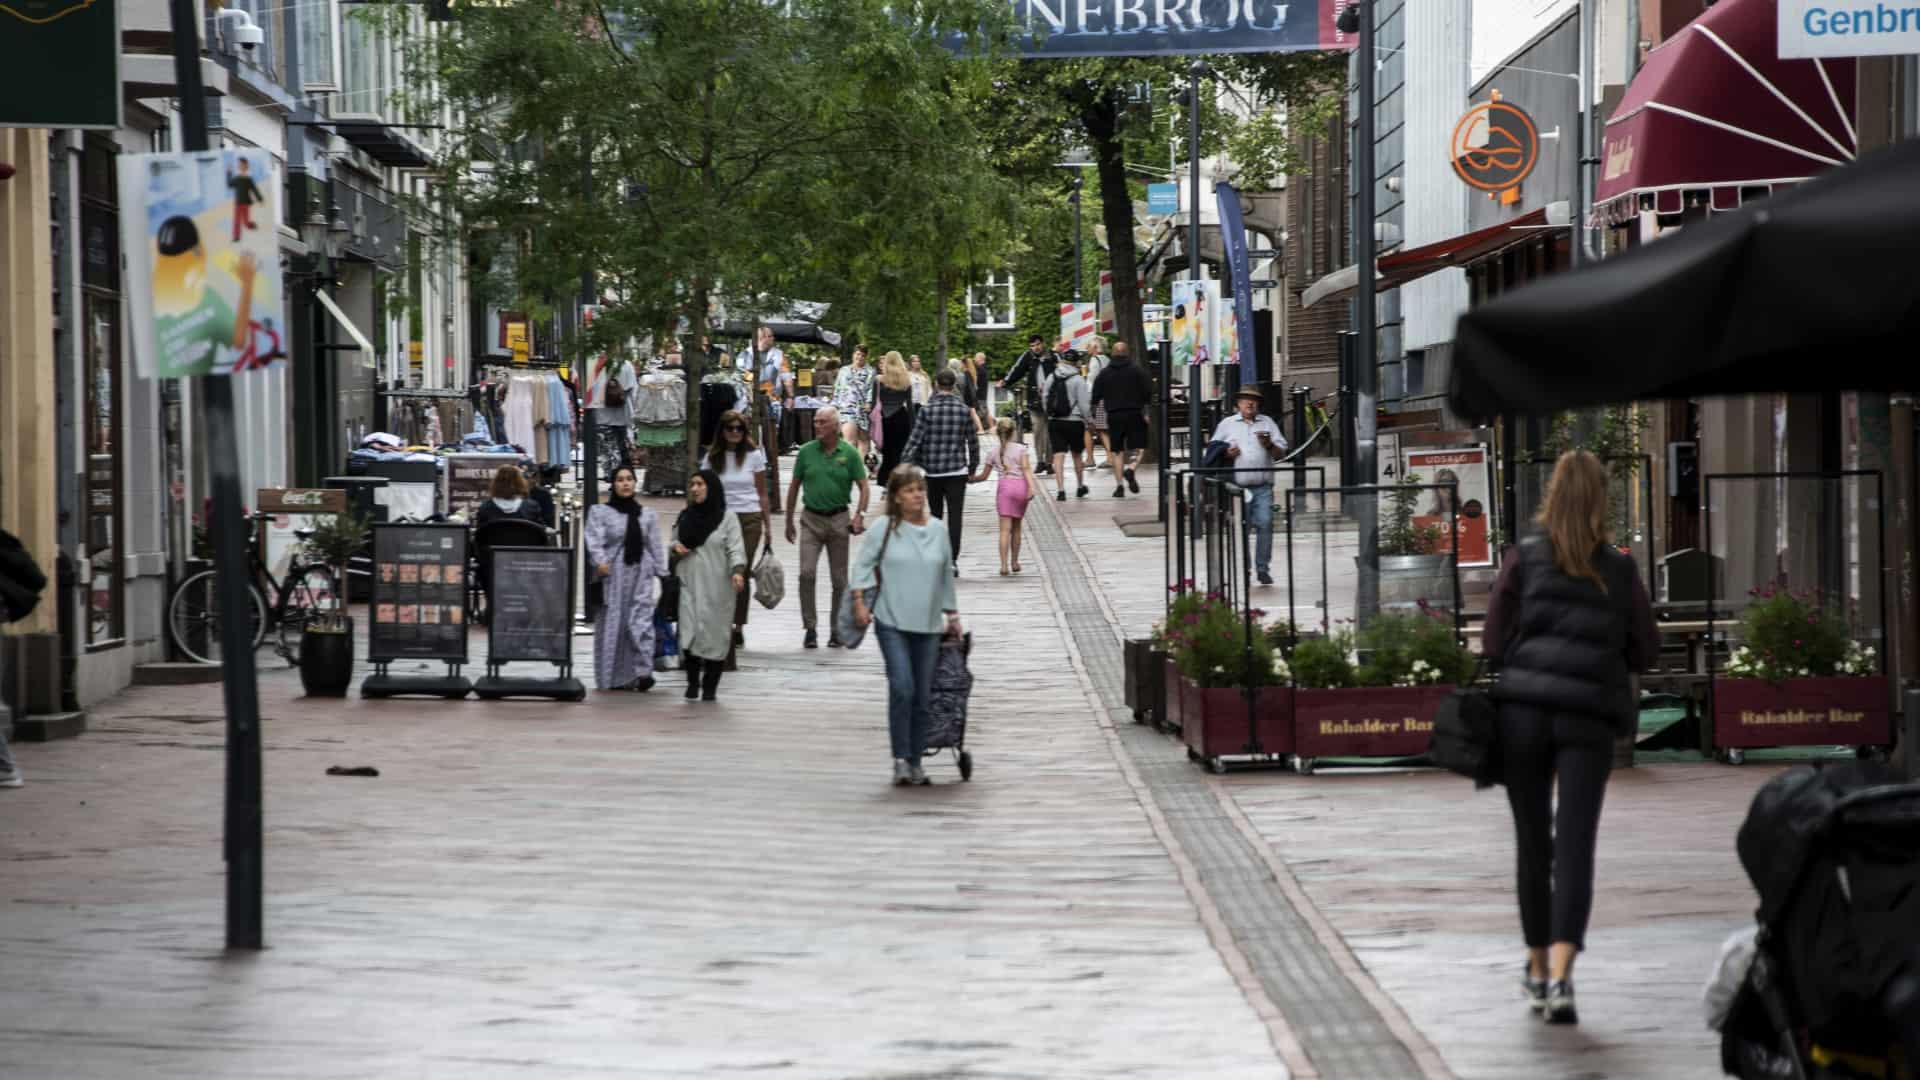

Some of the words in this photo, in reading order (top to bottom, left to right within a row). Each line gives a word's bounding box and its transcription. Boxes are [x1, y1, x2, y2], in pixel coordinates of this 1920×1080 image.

[1741, 709, 1825, 724] Rabalder
[1829, 708, 1864, 722] Bar
[1320, 718, 1400, 734] Rabalder
